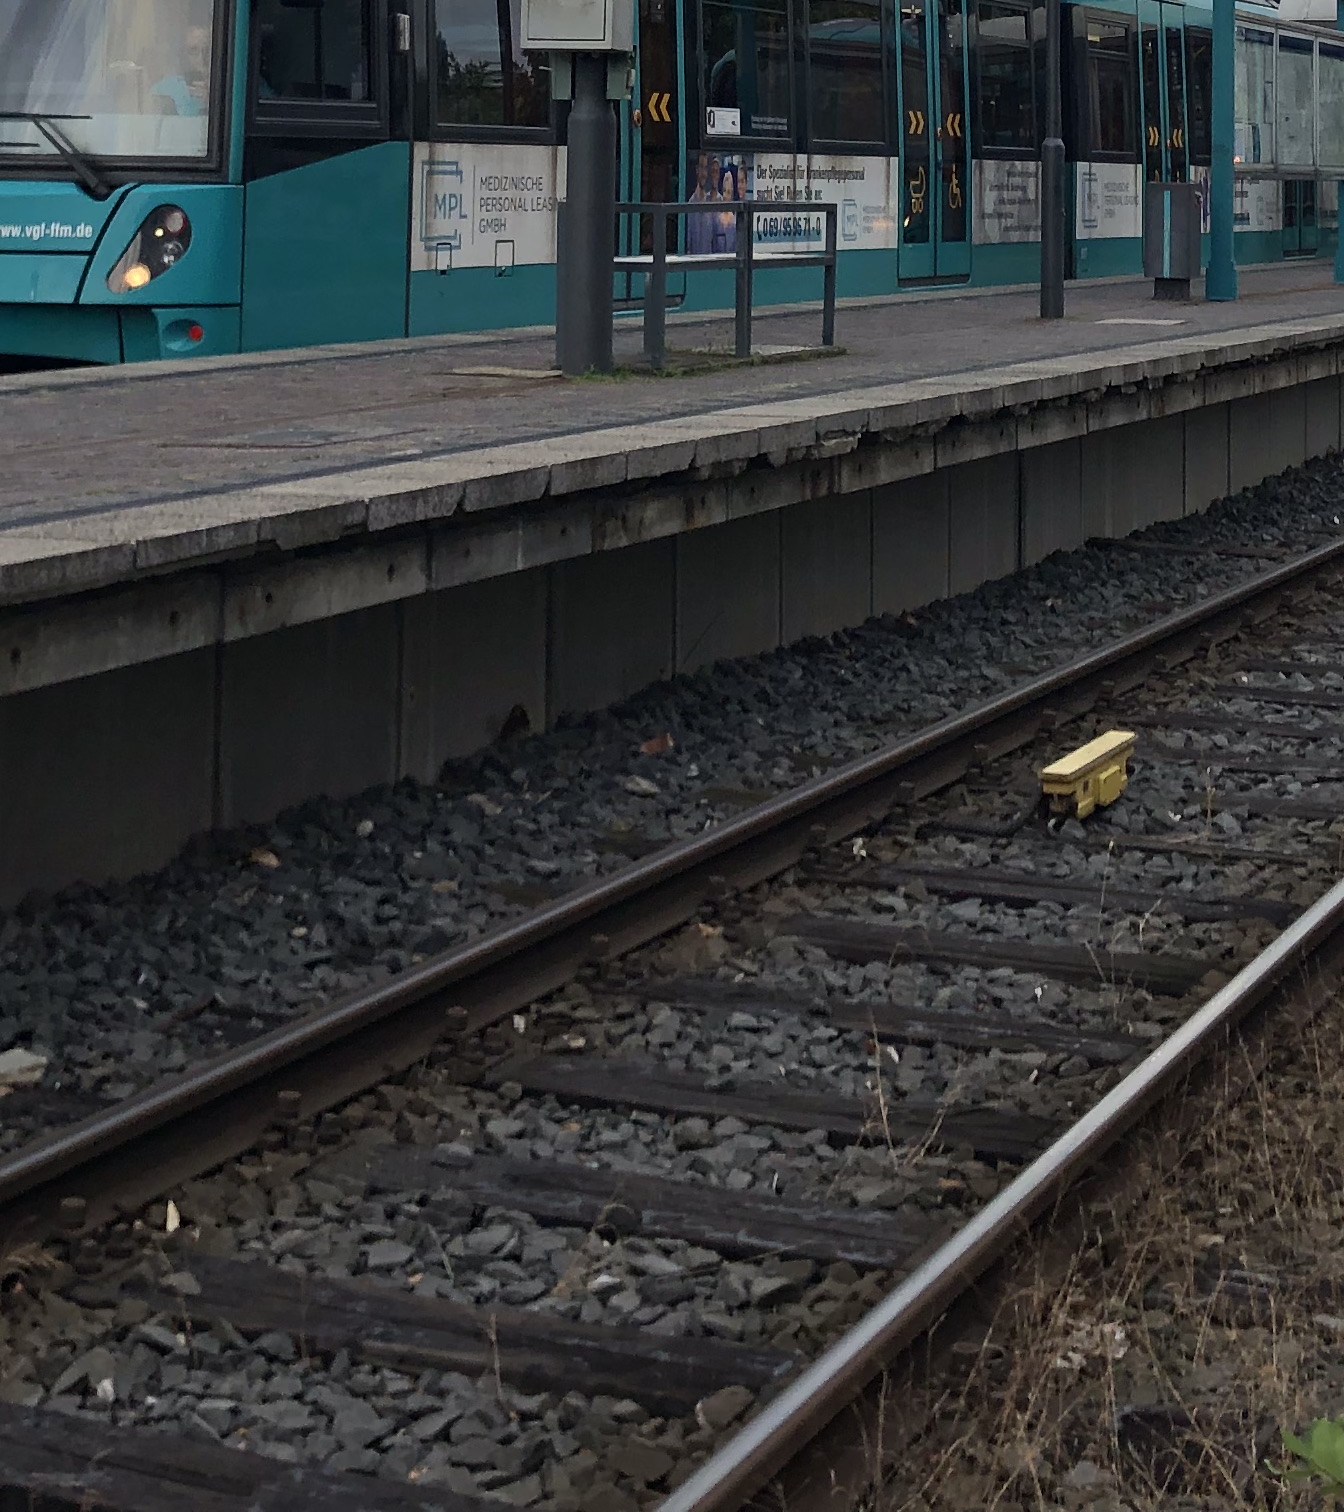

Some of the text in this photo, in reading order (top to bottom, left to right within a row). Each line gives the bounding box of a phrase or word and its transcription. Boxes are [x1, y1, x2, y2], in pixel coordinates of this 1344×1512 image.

[480, 176, 544, 192] MEDIZINISCHE
[434, 193, 467, 220] MPL
[479, 196, 528, 212] PERSONAL
[479, 218, 506, 233] GMBH
